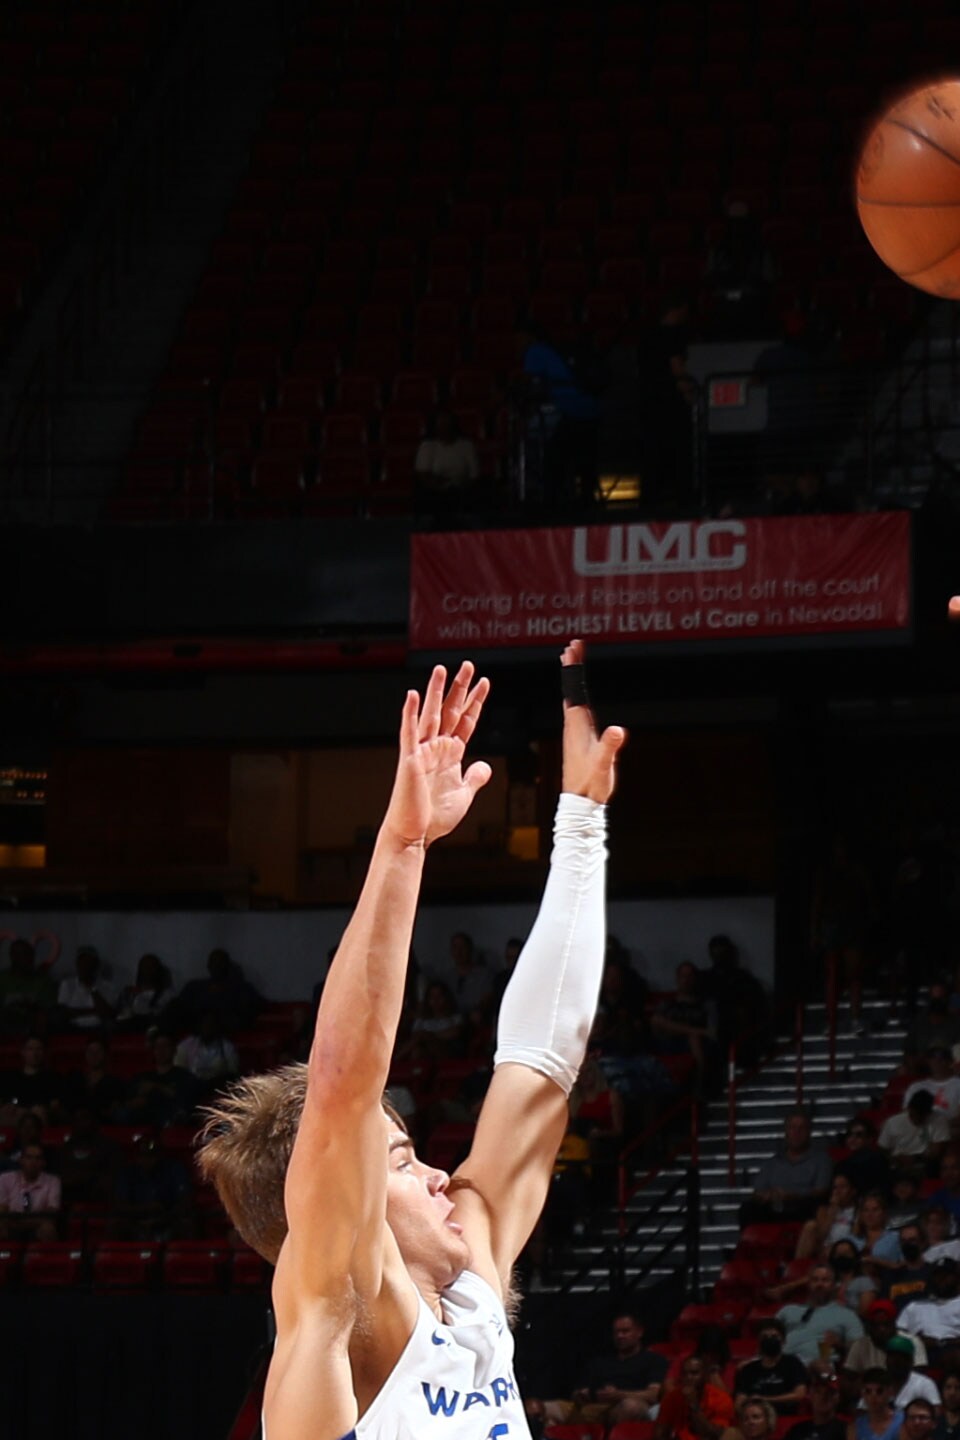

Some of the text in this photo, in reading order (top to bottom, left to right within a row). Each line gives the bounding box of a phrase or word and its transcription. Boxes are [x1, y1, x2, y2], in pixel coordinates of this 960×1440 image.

[571, 521, 748, 578] UMC
[441, 592, 513, 616] Caring
[517, 590, 546, 610] for
[551, 591, 586, 609] our
[665, 585, 694, 604] on
[696, 580, 743, 602] and
[748, 578, 777, 600] off
[782, 577, 816, 598] the
[822, 572, 881, 597] court
[437, 618, 481, 640] with
[487, 617, 521, 638] the
[526, 613, 612, 637] HIGHEST
[617, 609, 674, 633] LEVEL
[680, 608, 703, 630] of
[706, 607, 760, 630] Care
[764, 605, 784, 626] in
